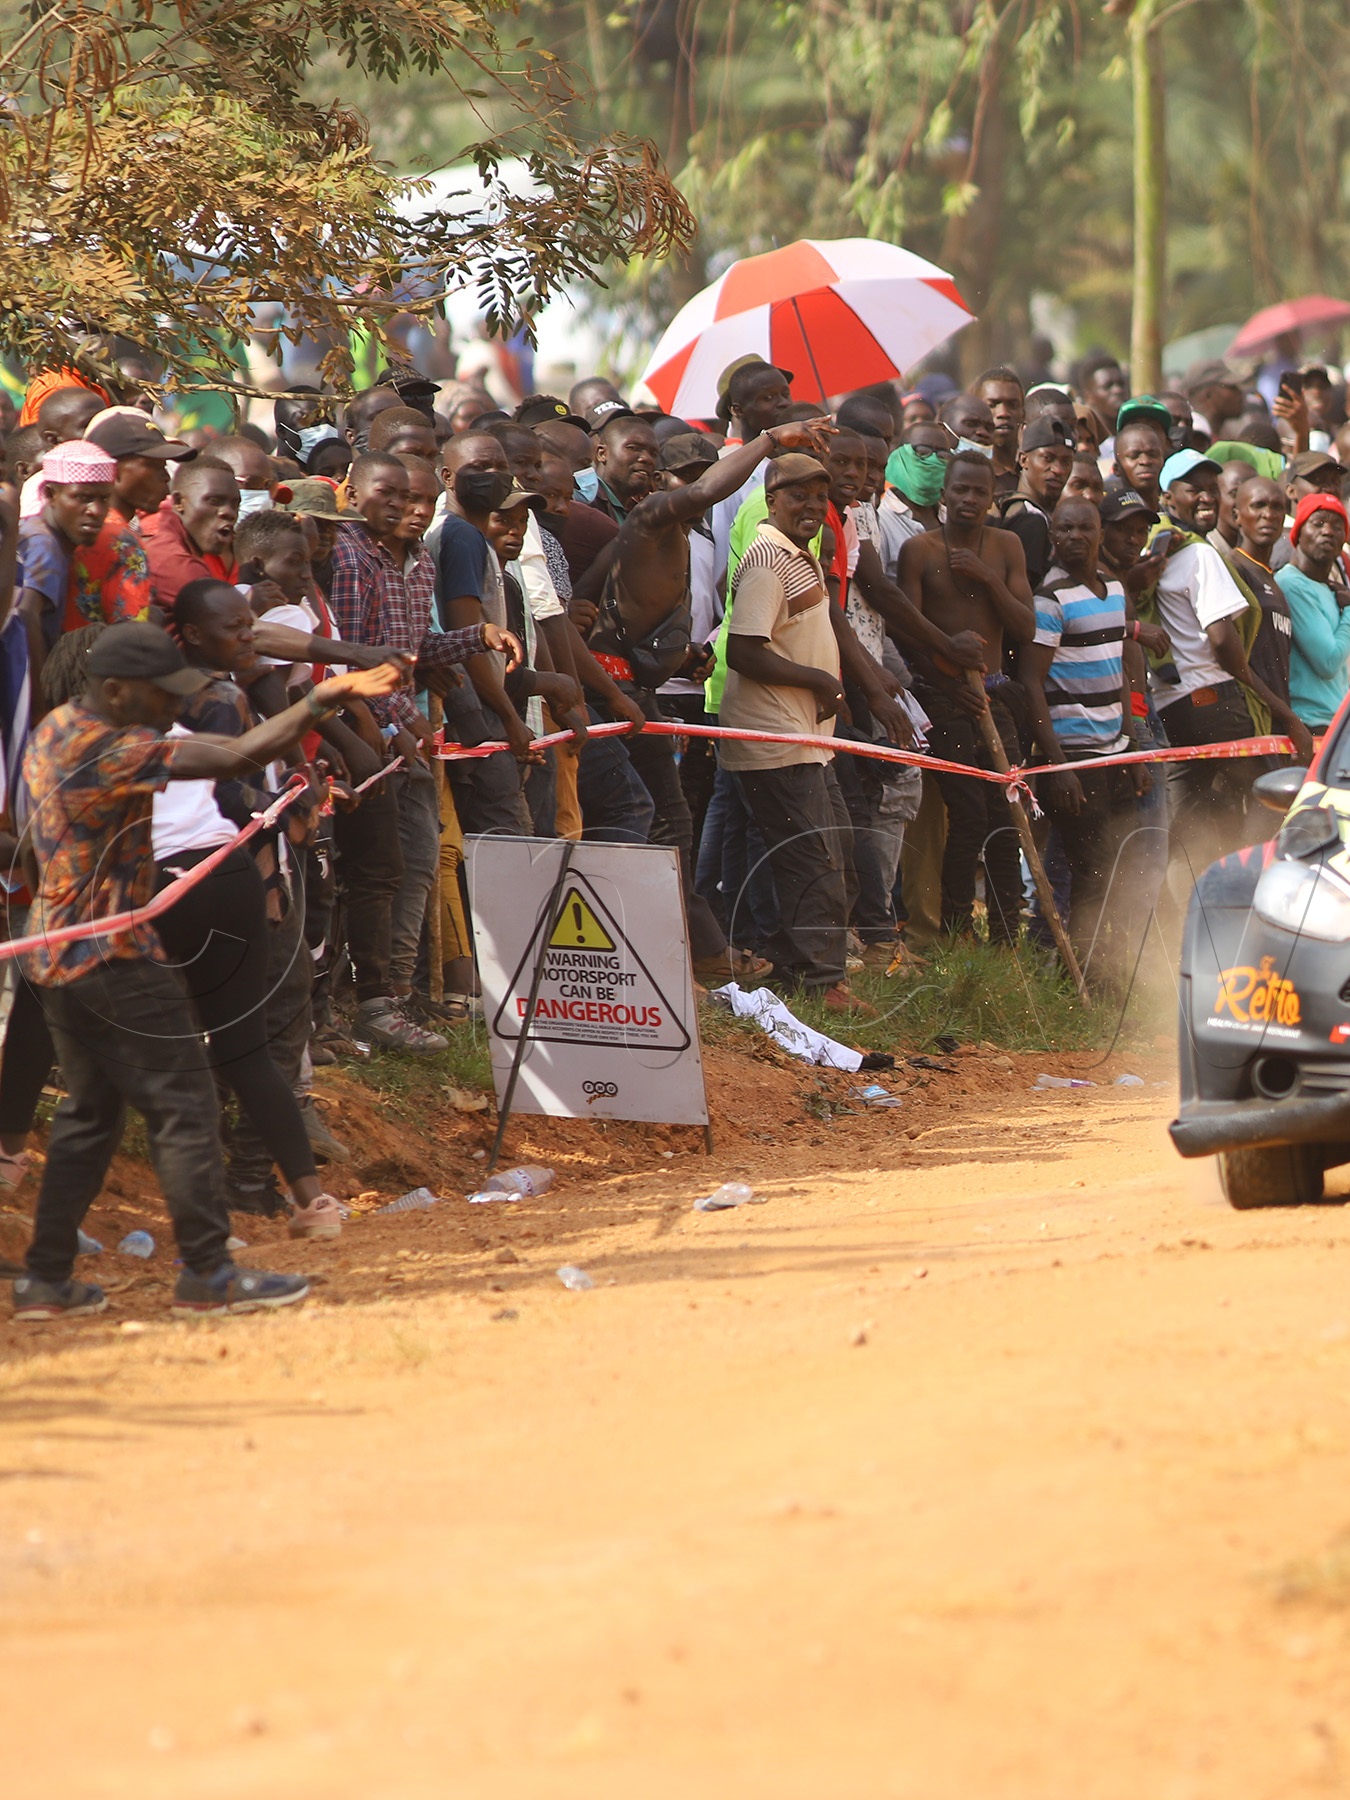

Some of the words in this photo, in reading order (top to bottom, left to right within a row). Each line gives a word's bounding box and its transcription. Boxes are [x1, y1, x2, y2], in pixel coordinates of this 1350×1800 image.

[546, 952, 620, 969] WARNING
[533, 967, 637, 987] MOTORSPORT
[559, 984, 592, 999] CAN
[596, 986, 616, 1001] BE
[1214, 965, 1302, 1026] Retro
[516, 997, 662, 1027] DANGEROUS
